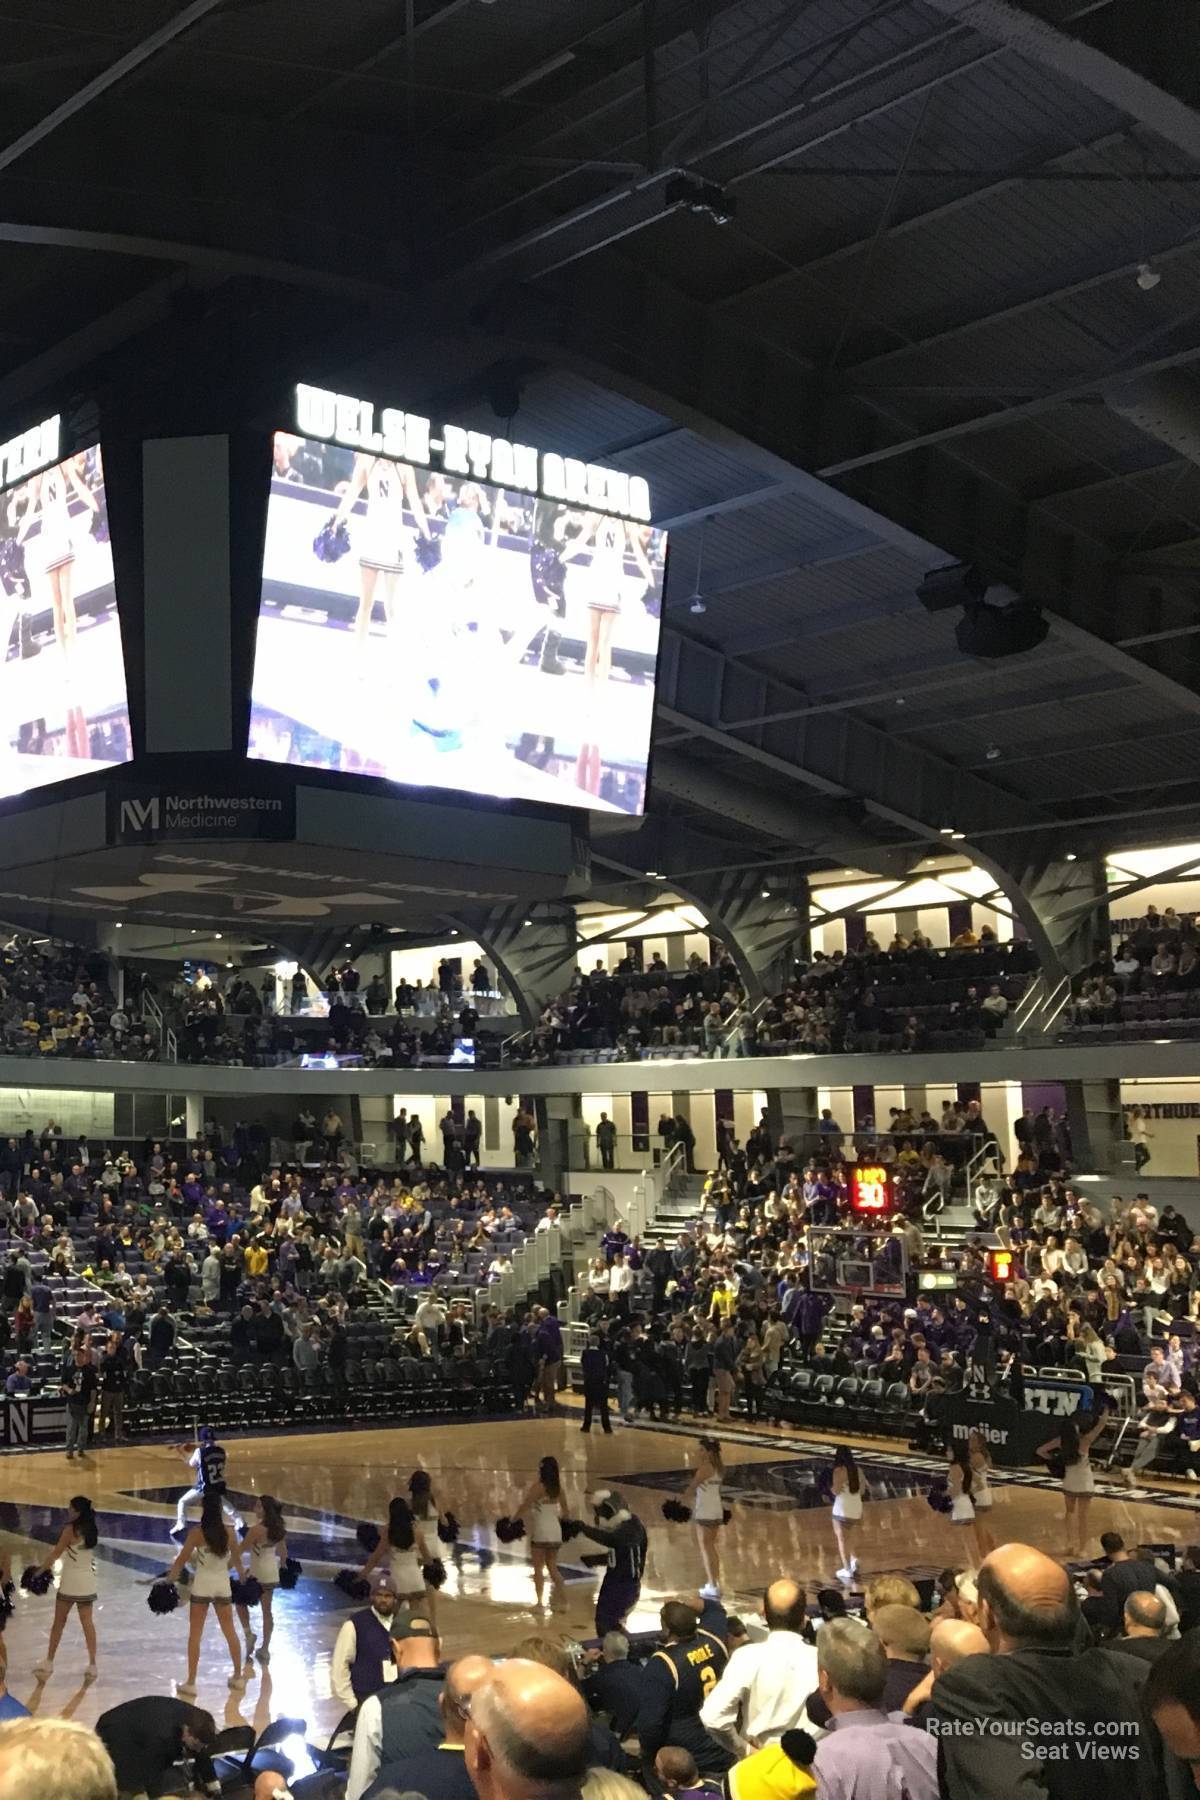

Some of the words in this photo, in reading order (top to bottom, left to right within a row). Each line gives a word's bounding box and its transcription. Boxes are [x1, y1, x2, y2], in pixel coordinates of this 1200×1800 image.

[165, 794, 283, 812] Northwestern
[165, 813, 238, 829] Medicine
[8, 1402, 30, 1444] N
